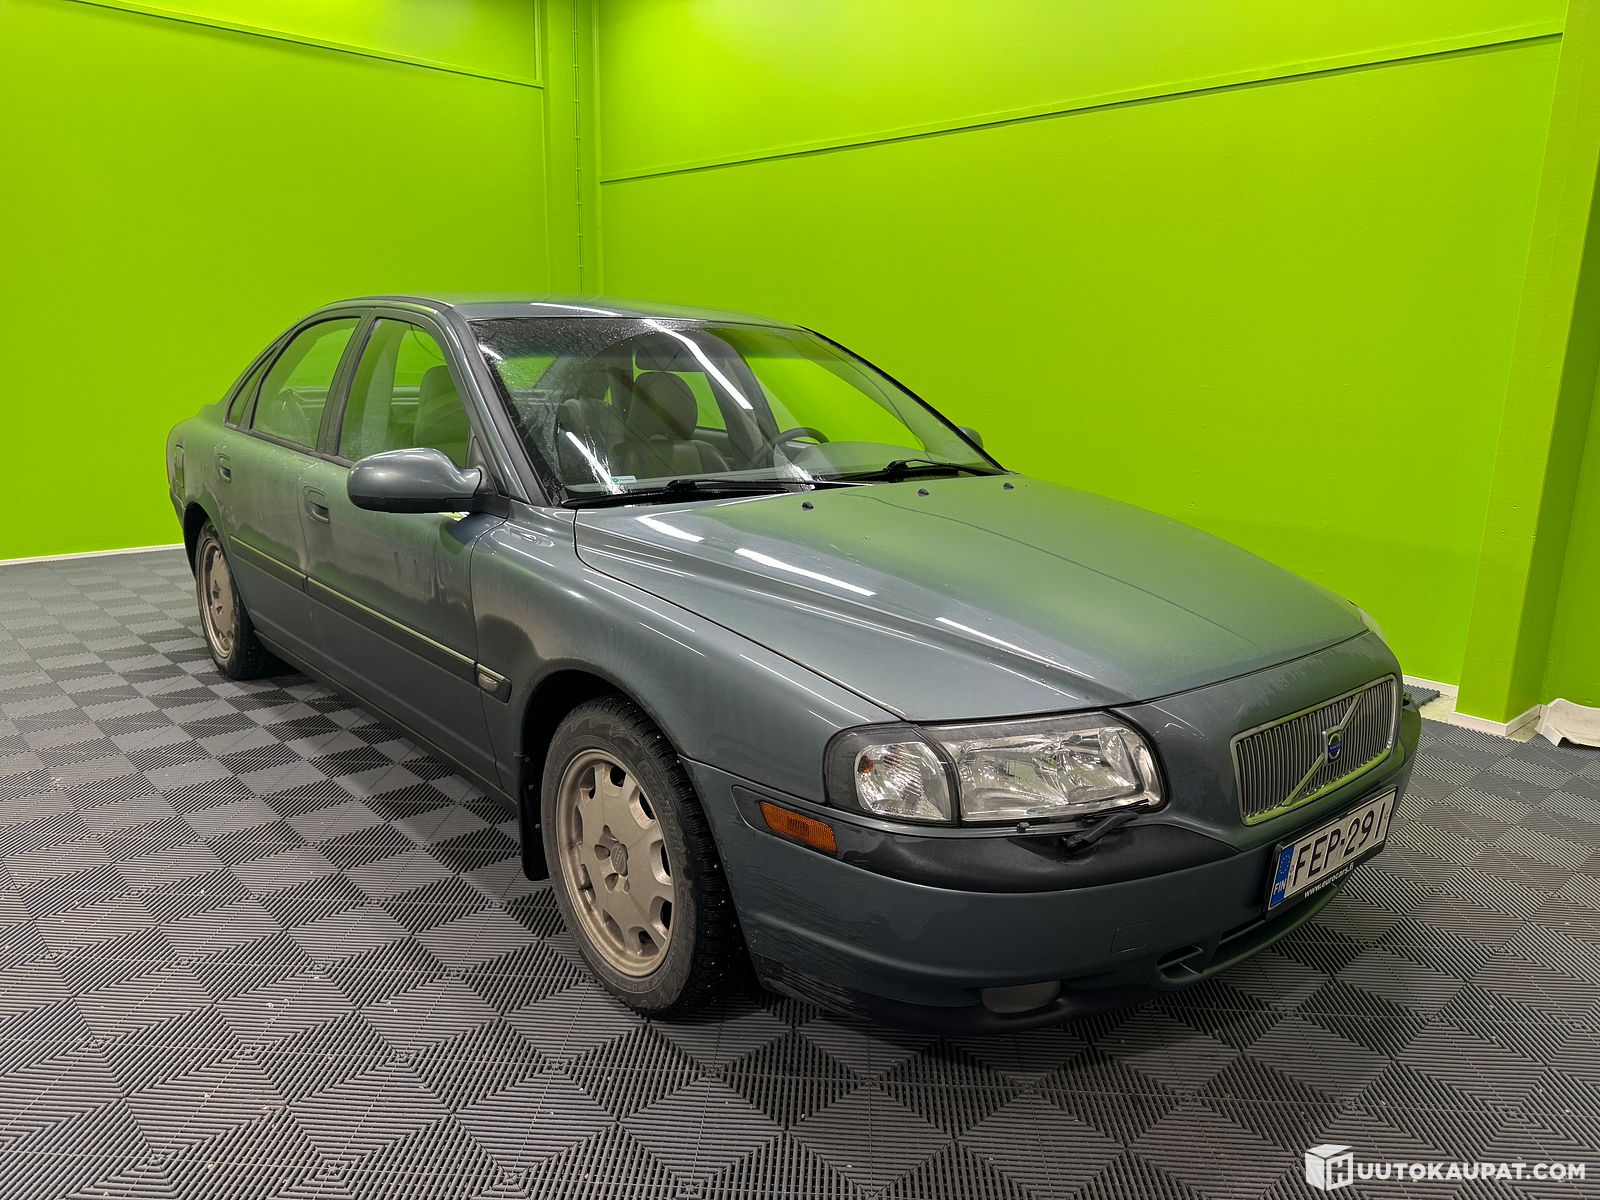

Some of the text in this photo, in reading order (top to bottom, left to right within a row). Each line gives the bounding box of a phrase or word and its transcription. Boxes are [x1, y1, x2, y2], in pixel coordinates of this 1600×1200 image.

[1291, 802, 1386, 888] FEP-291
[1273, 878, 1287, 896] FIN
[1304, 861, 1354, 898] www.eurocars.fi
